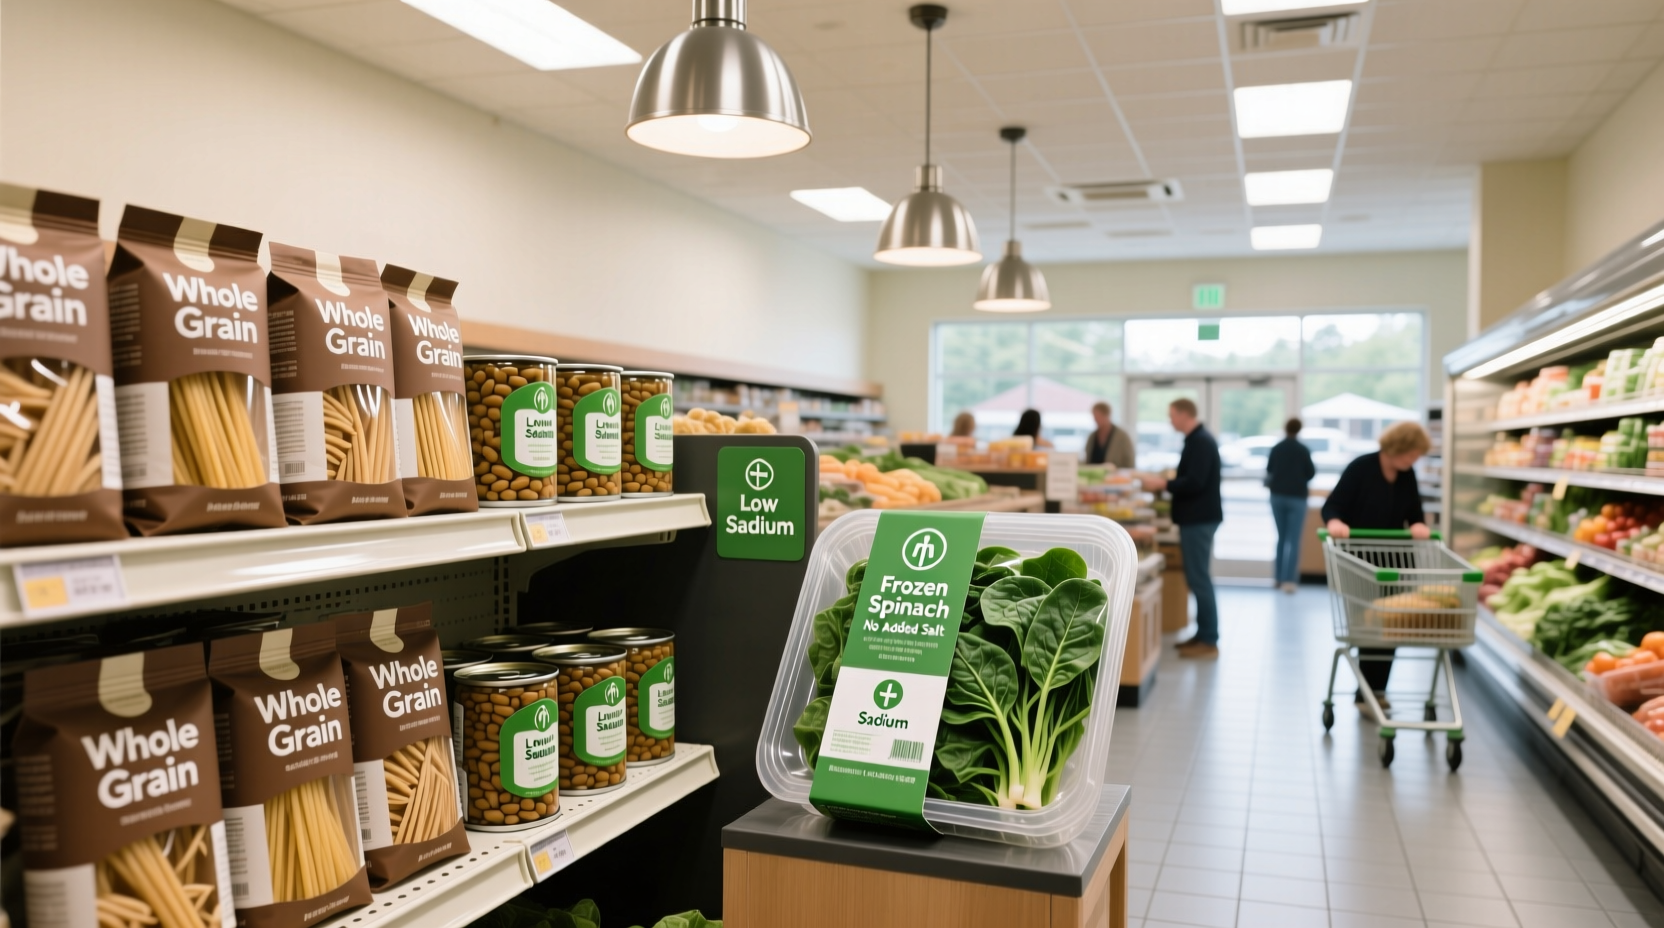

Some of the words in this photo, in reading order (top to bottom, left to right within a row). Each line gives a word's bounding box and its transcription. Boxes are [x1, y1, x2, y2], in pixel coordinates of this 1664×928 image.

[0, 245, 89, 290] hole
[162, 272, 259, 312] Whole
[174, 306, 258, 344] Grain
[314, 298, 385, 332] Whole
[407, 313, 460, 344] Whole
[325, 328, 386, 360] Grain
[416, 340, 463, 369] Grain
[740, 493, 779, 514] Low
[725, 514, 795, 536] Sadium
[880, 575, 949, 597] Frozen
[867, 596, 950, 619] Spinach
[863, 619, 879, 632] No
[882, 621, 919, 635] Added
[921, 623, 945, 637] Salt
[369, 655, 439, 690] Whole
[254, 682, 342, 725] Whole
[382, 688, 442, 719] Grain
[267, 715, 343, 757] Grain
[857, 711, 909, 730] Sadium
[81, 718, 199, 770] Whole
[98, 756, 199, 809] Grain
